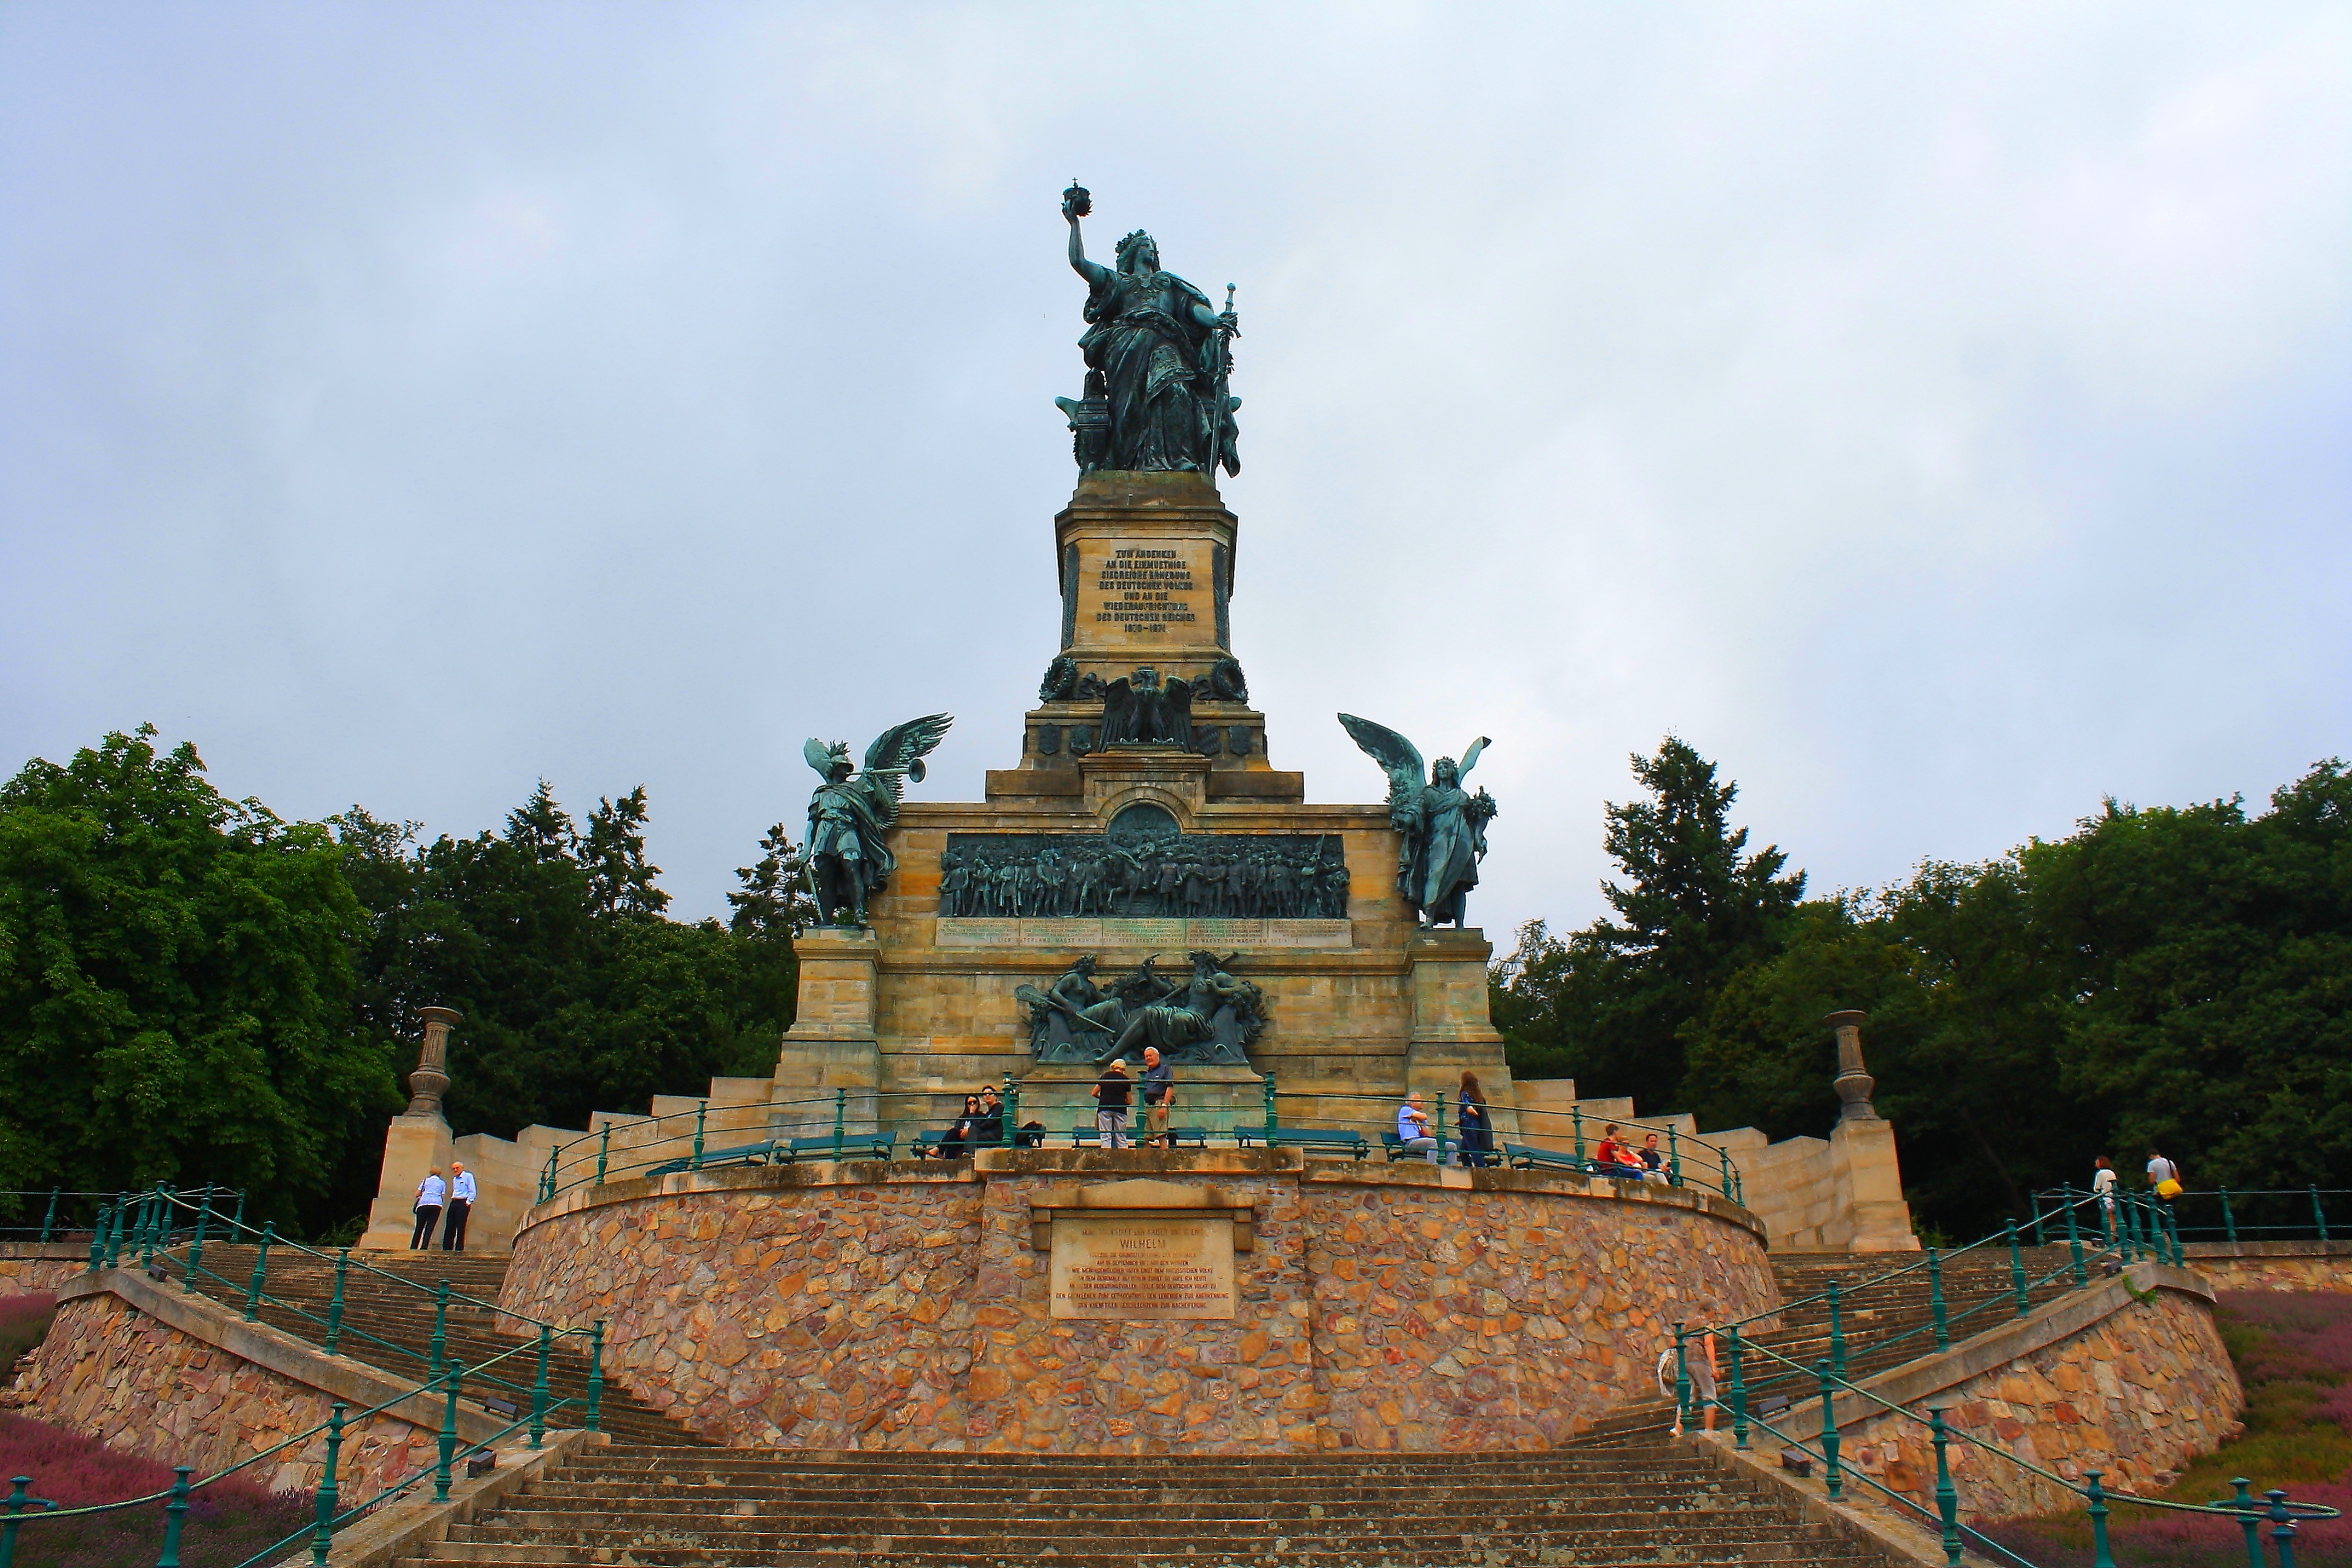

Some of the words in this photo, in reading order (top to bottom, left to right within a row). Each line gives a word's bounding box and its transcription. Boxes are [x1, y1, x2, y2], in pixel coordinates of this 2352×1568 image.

[1105, 560, 1116, 569] AN
[1119, 560, 1132, 569] DIE
[1124, 592, 1139, 600] UND
[1142, 592, 1153, 600] AN
[1155, 592, 1168, 600] DIE
[1120, 1239, 1165, 1248] WILHELM
